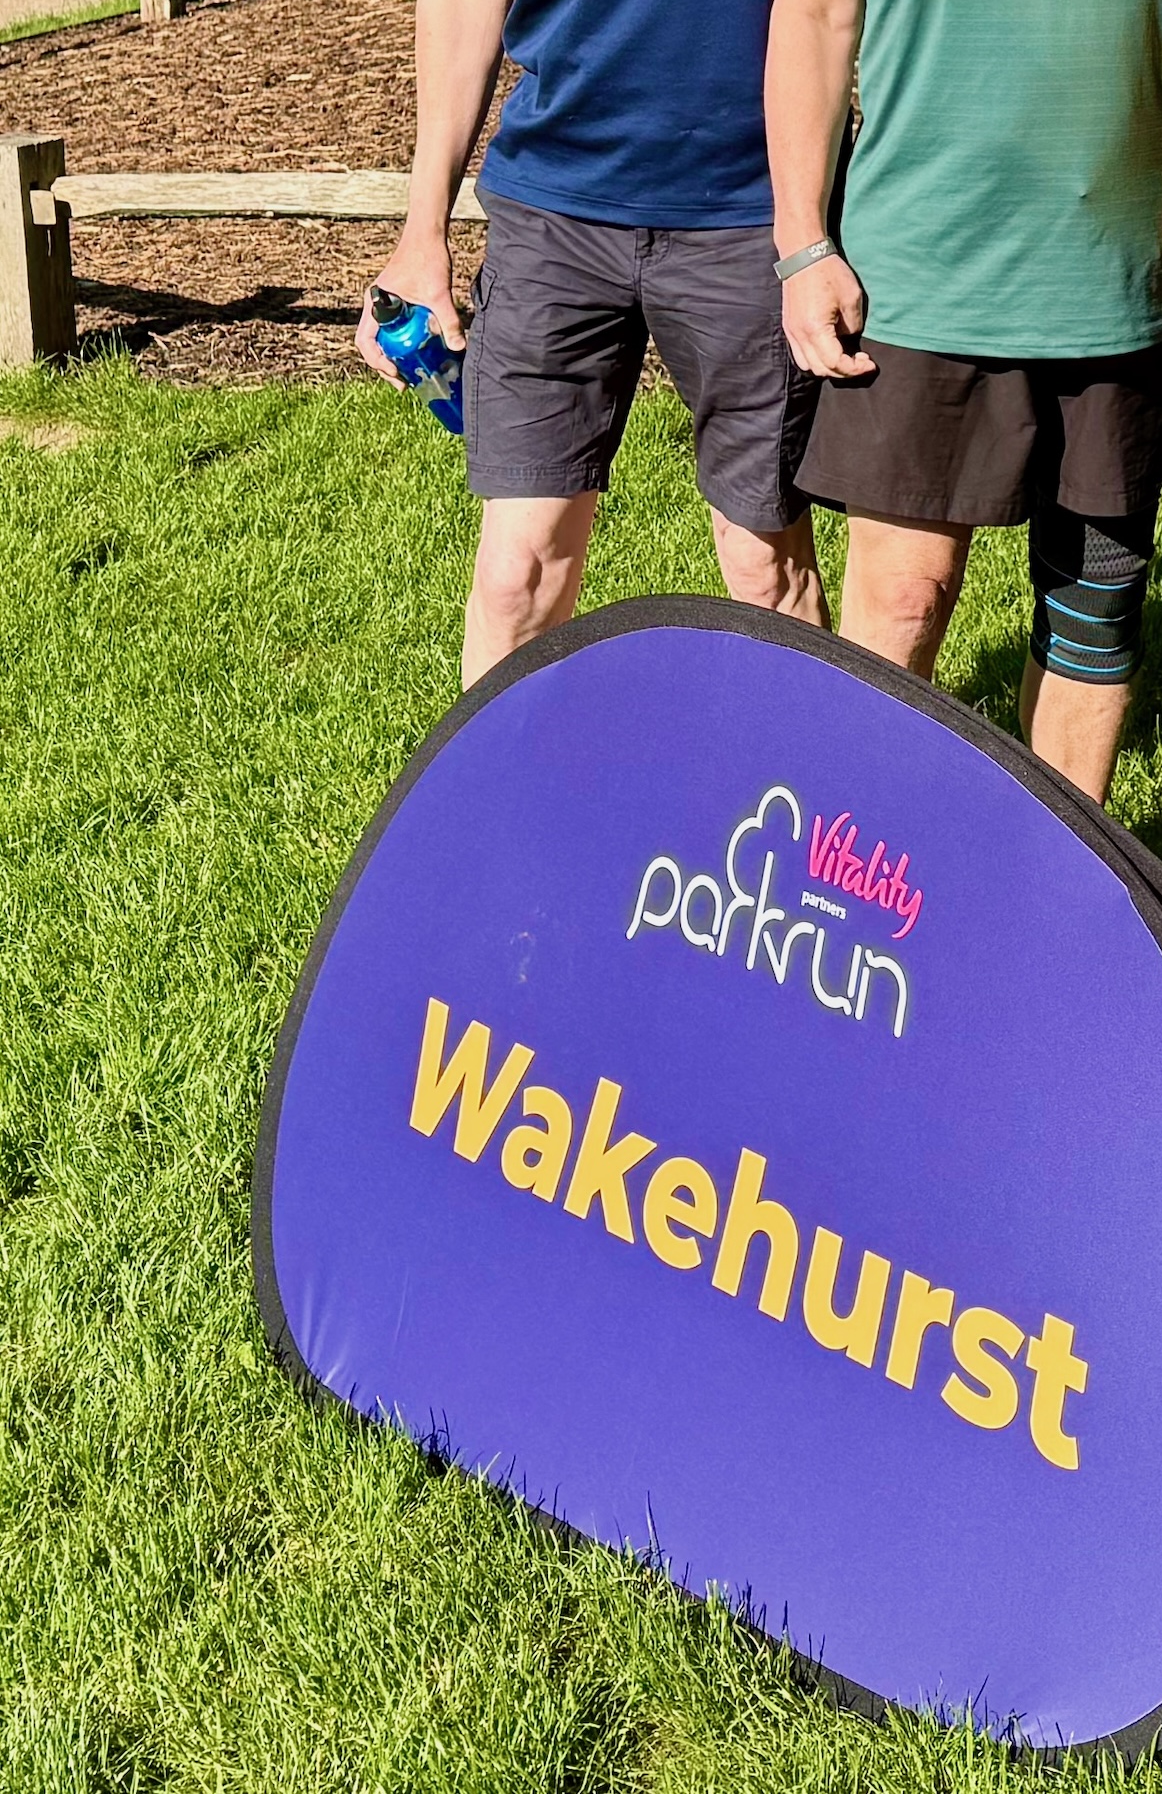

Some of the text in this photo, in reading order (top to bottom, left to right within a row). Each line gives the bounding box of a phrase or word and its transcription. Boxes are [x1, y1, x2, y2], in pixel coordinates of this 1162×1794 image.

[626, 785, 908, 1039] parkrun
[801, 890, 847, 921] partners
[809, 811, 924, 939] Vitality
[409, 996, 1089, 1470] Wakehurst
